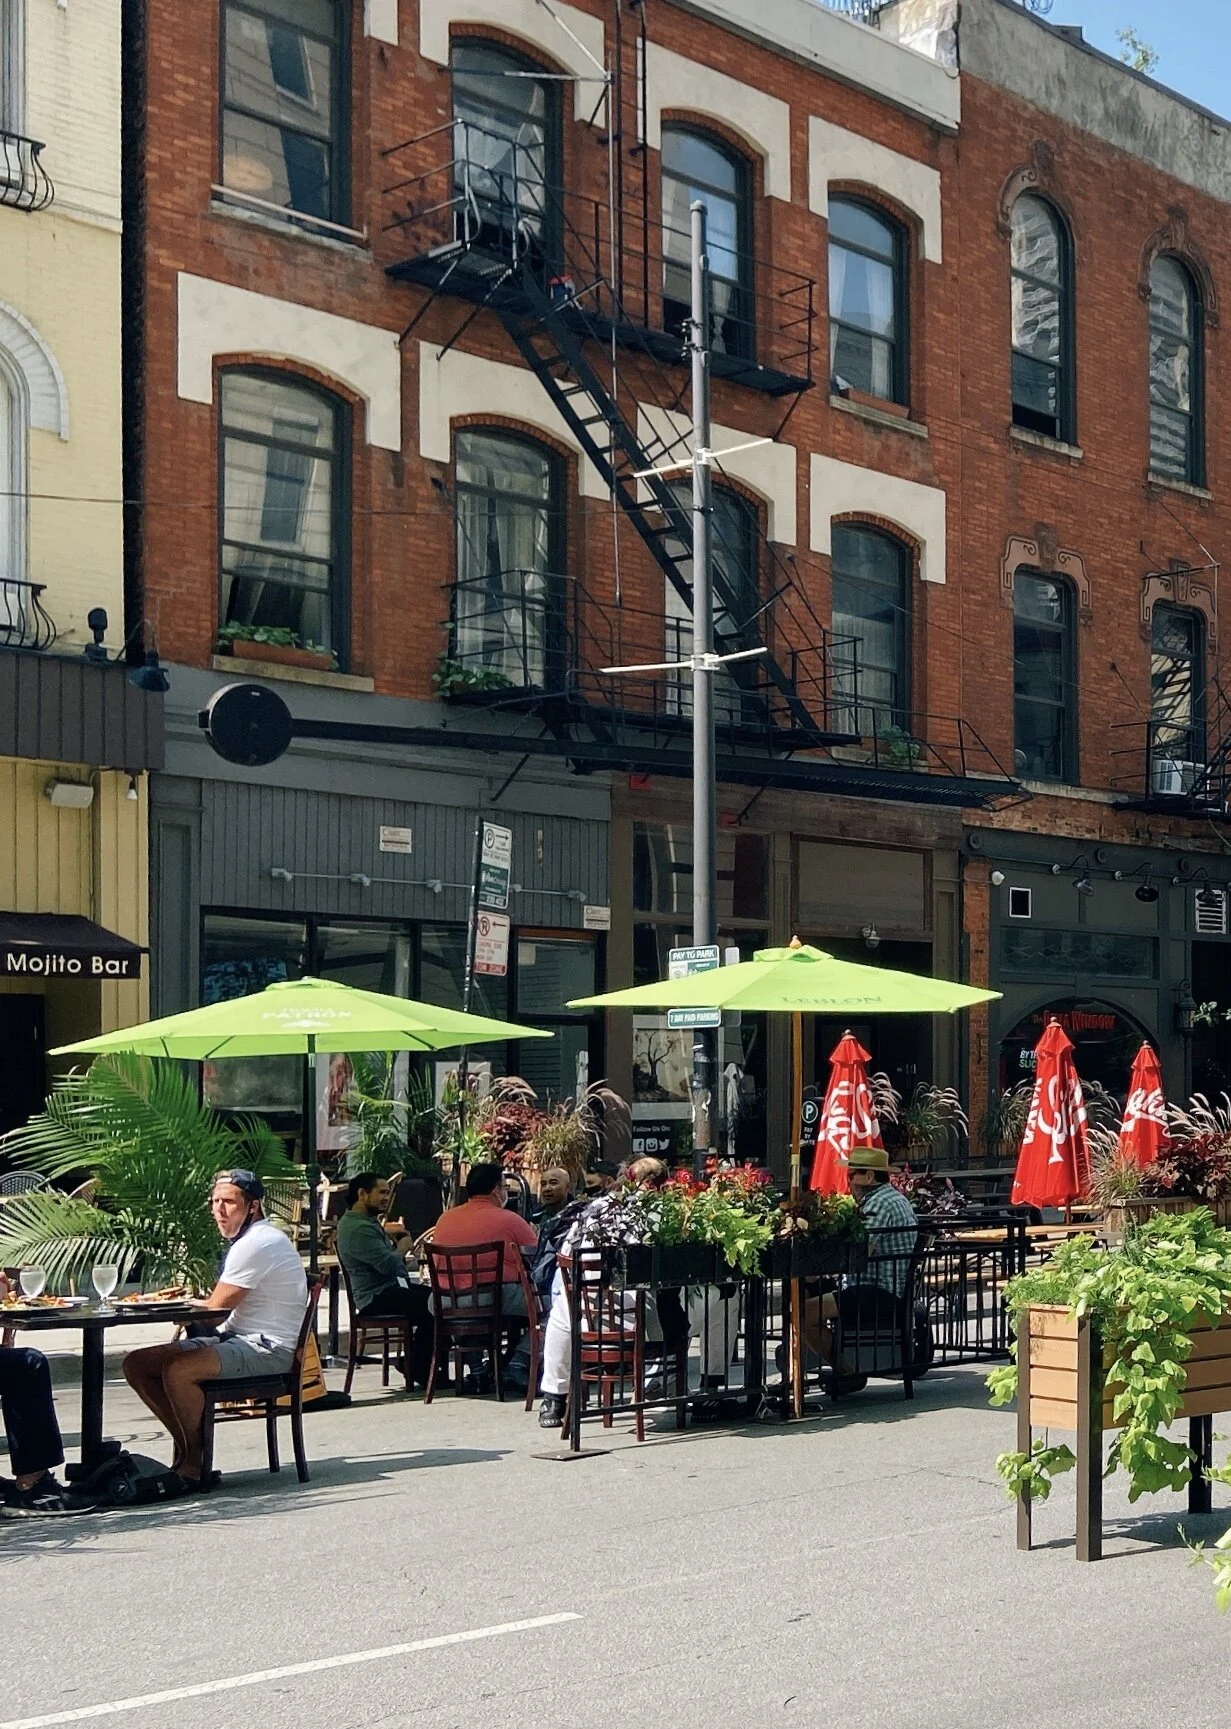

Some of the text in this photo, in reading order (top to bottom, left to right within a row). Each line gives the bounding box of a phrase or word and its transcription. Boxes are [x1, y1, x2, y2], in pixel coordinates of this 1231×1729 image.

[672, 949, 714, 960] PAY TO PARK
[7, 953, 128, 976] Mojito Bar
[696, 1012, 719, 1022] PARKING
[1020, 1049, 1029, 1059] BY
[1019, 1059, 1036, 1068] SLIC
[805, 1104, 814, 1119] P
